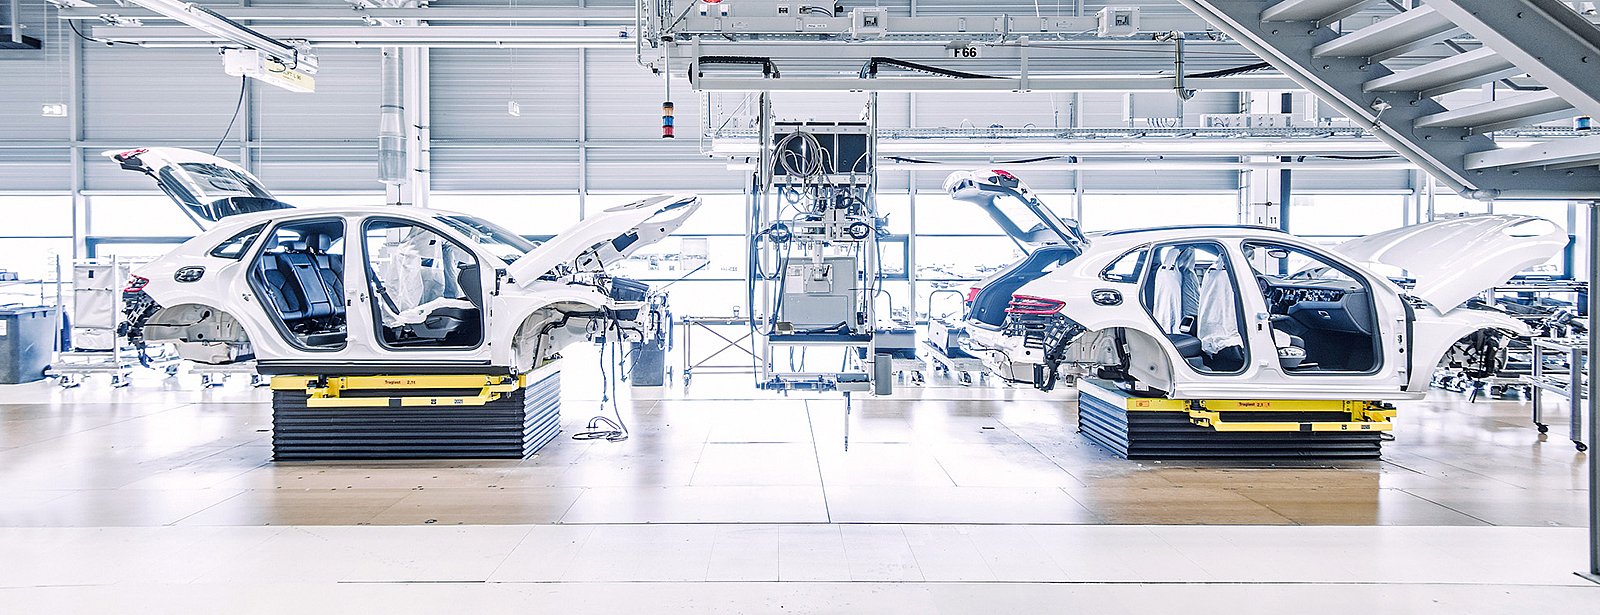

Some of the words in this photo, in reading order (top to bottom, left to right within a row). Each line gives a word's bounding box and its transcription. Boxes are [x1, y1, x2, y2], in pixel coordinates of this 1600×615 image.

[954, 48, 960, 58] F
[962, 47, 977, 58] 66
[1258, 216, 1263, 224] L
[1270, 216, 1277, 224] 11
